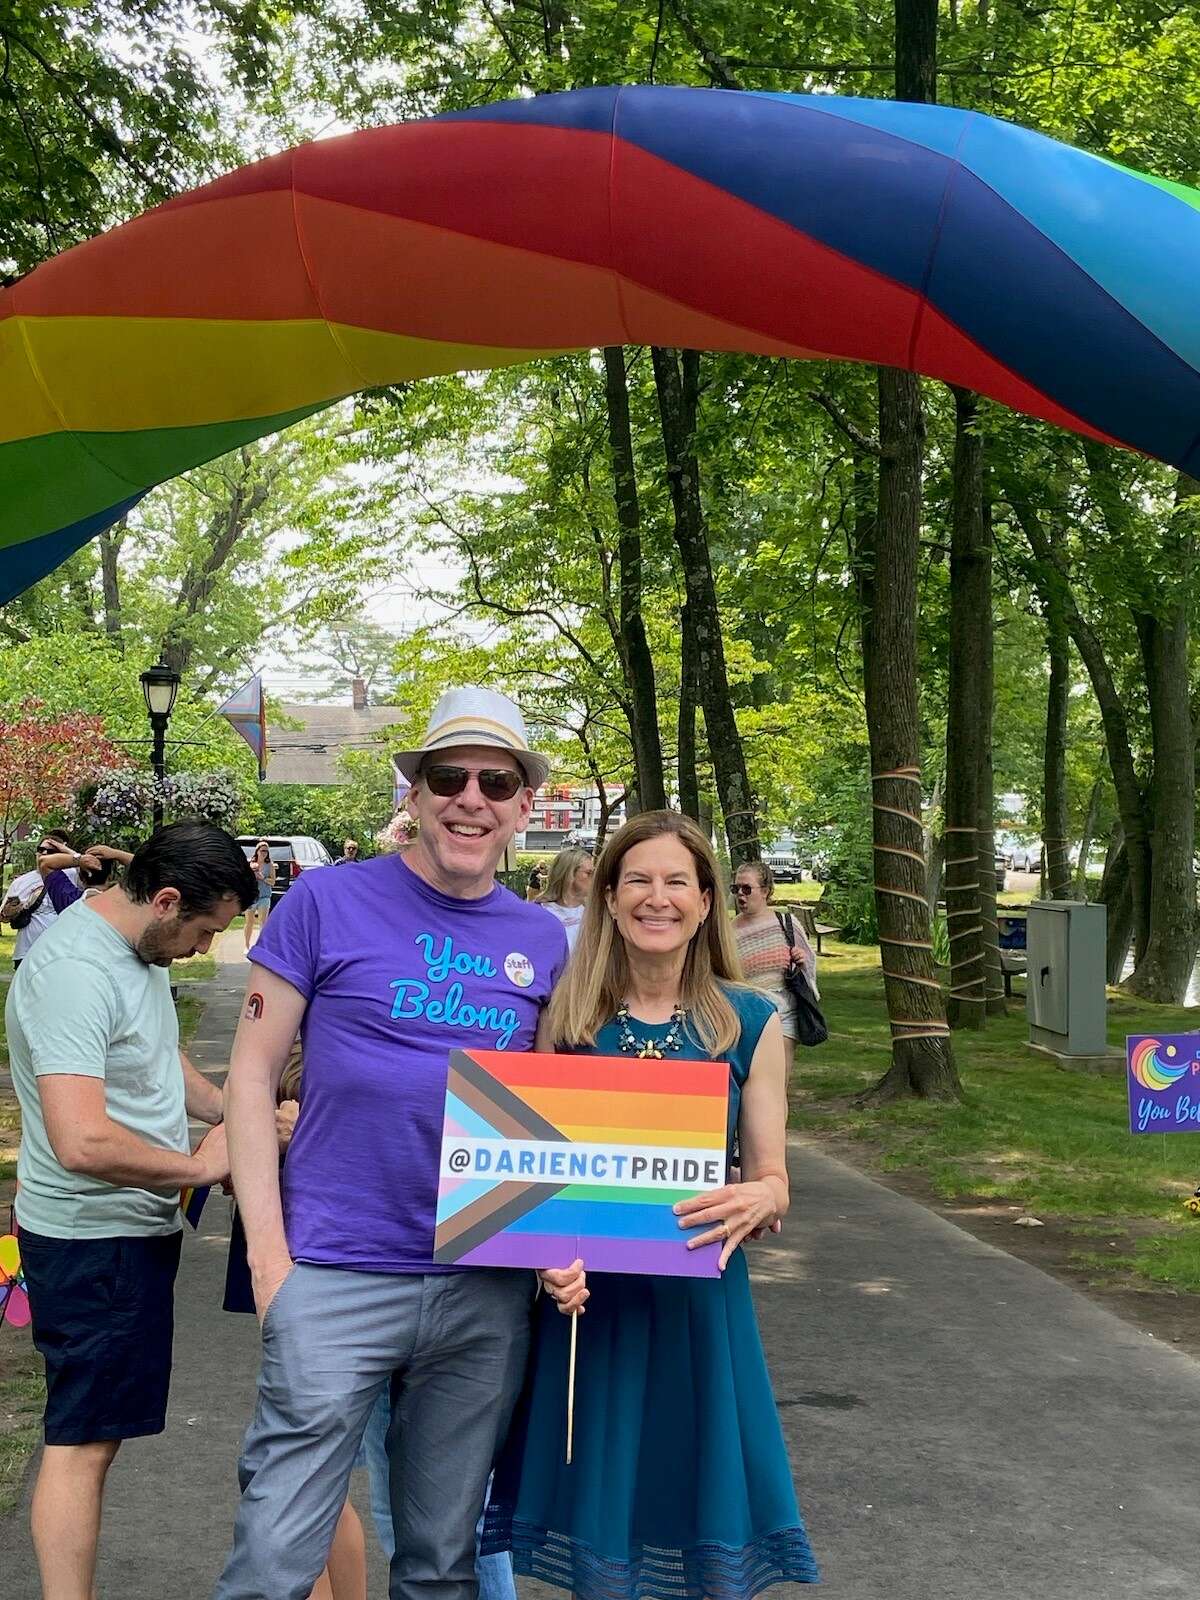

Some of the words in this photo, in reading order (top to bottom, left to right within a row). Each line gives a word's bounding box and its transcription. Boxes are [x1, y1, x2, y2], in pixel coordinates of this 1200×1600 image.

[414, 933, 497, 982] You
[389, 979, 521, 1051] Belong
[1138, 1097, 1171, 1131] You
[449, 1148, 719, 1183] @DARIENCTPRIDE
